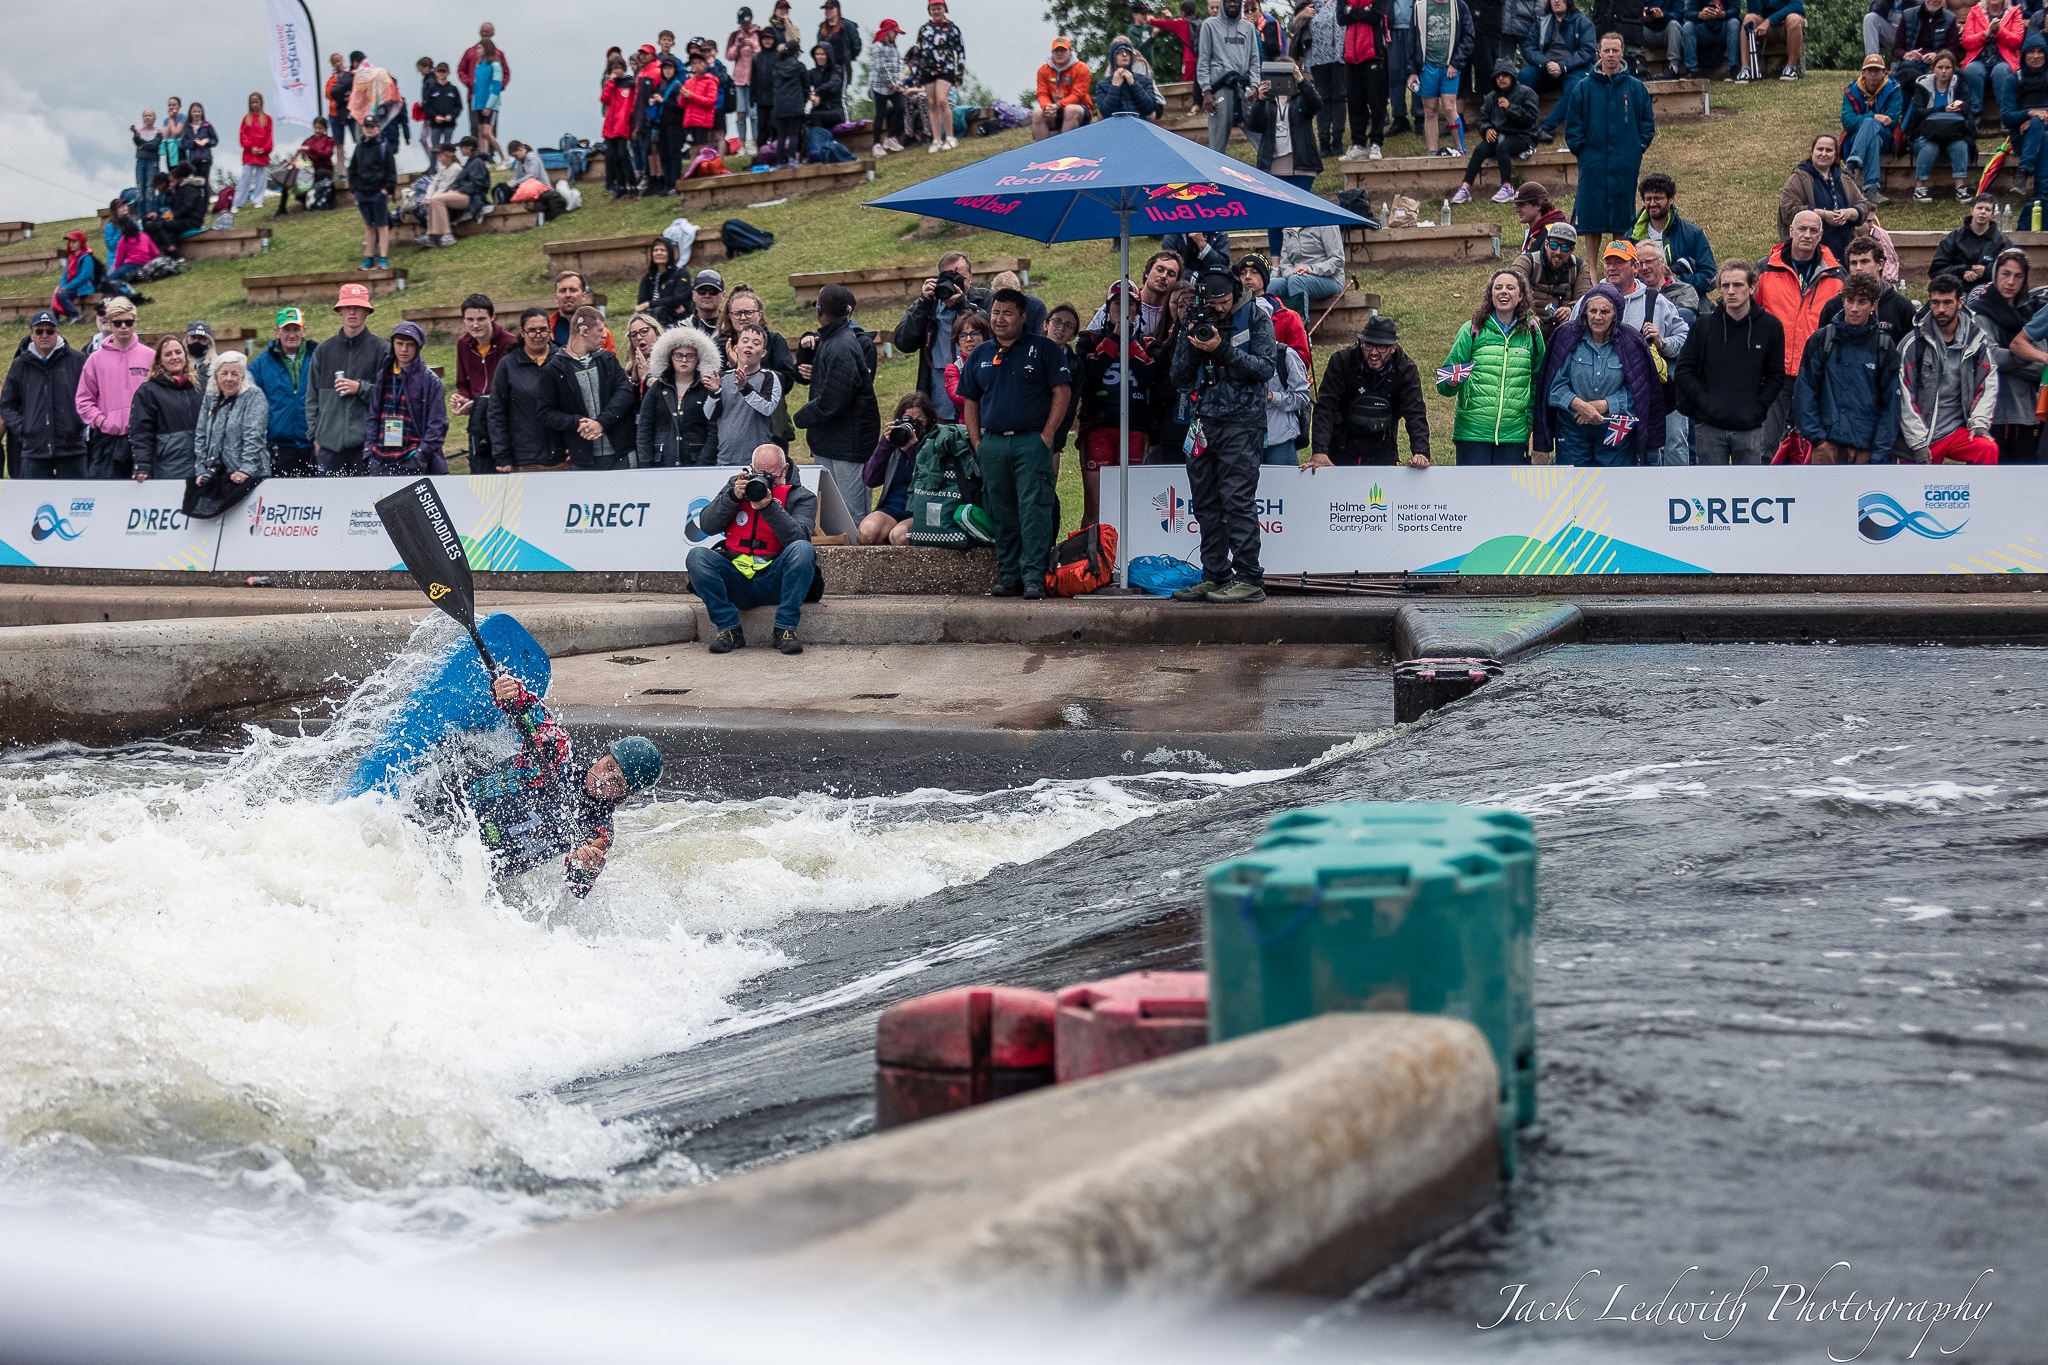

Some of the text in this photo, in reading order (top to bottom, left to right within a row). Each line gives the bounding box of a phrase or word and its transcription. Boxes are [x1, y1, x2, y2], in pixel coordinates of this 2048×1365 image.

[995, 169, 1103, 187] Red Bull
[1924, 490, 1970, 501] canoe
[70, 502, 95, 511] canoe
[1329, 501, 1366, 512] Holme
[1925, 501, 1970, 509] federation
[266, 504, 322, 524] BRITISH
[565, 502, 651, 528] DIRECT
[1668, 497, 1796, 525] DIRECT
[414, 483, 462, 561] #SHEPADDLES
[1329, 512, 1388, 525] Pierrepont
[1397, 512, 1467, 522] National Water
[263, 526, 319, 537] CANOEING
[1329, 523, 1383, 533] Country Park
[1397, 523, 1463, 533] Sports Centre
